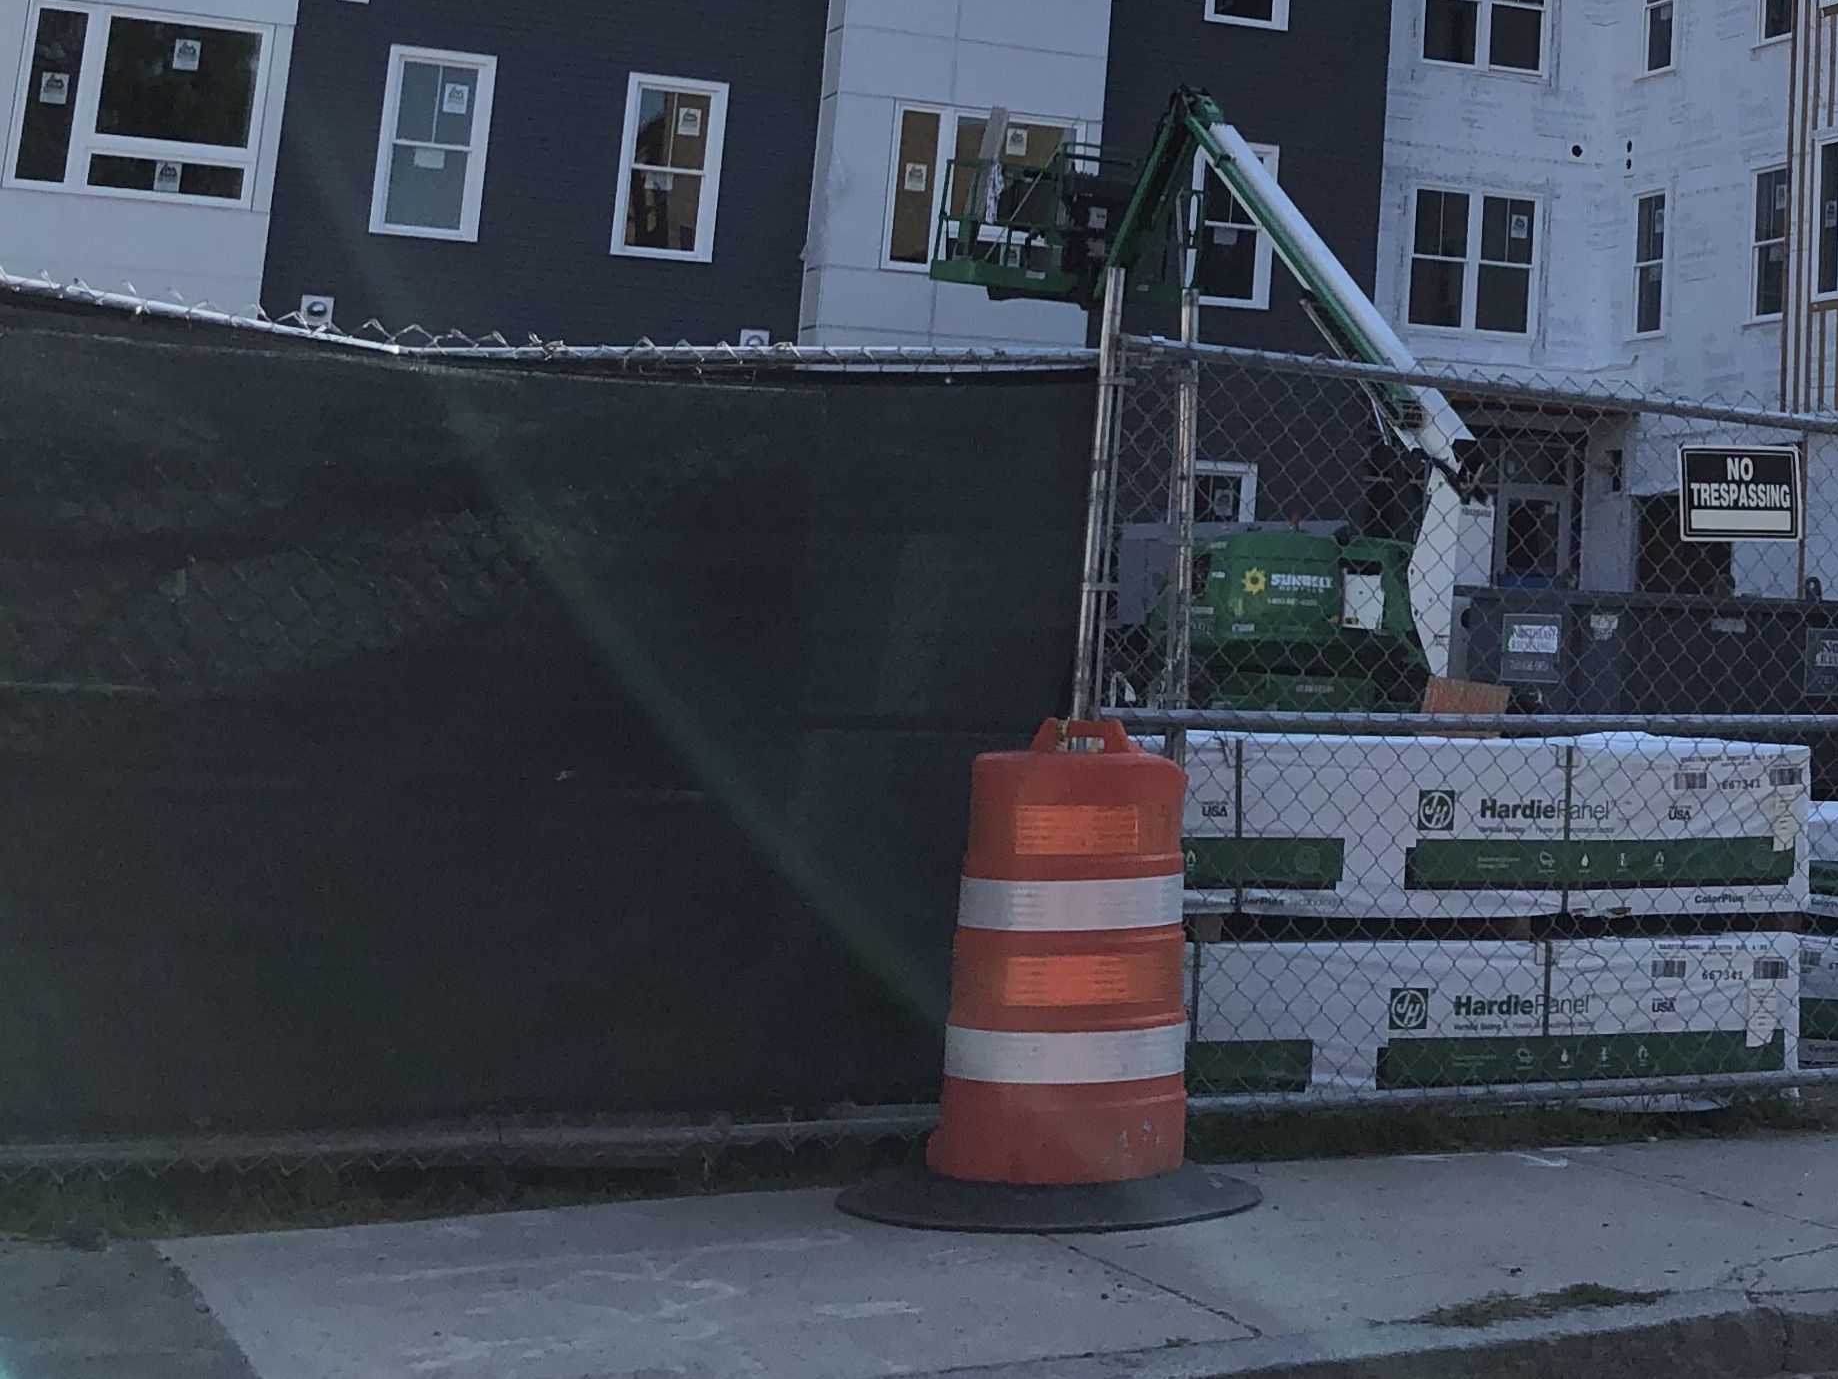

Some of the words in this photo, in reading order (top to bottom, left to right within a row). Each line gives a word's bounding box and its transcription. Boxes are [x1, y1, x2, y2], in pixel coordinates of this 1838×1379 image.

[1726, 457, 1754, 481] NO
[1690, 482, 1791, 508] TRESPASSING
[1271, 574, 1333, 589] SUNBELT
[1202, 805, 1228, 817] USA
[1480, 798, 1609, 820] HardiePanel
[1668, 810, 1691, 820] USA
[1695, 894, 1744, 905] ColorPlus
[1701, 969, 1744, 981] 667341
[1454, 994, 1590, 1017] HardiePanel
[1652, 1000, 1676, 1012] USA
